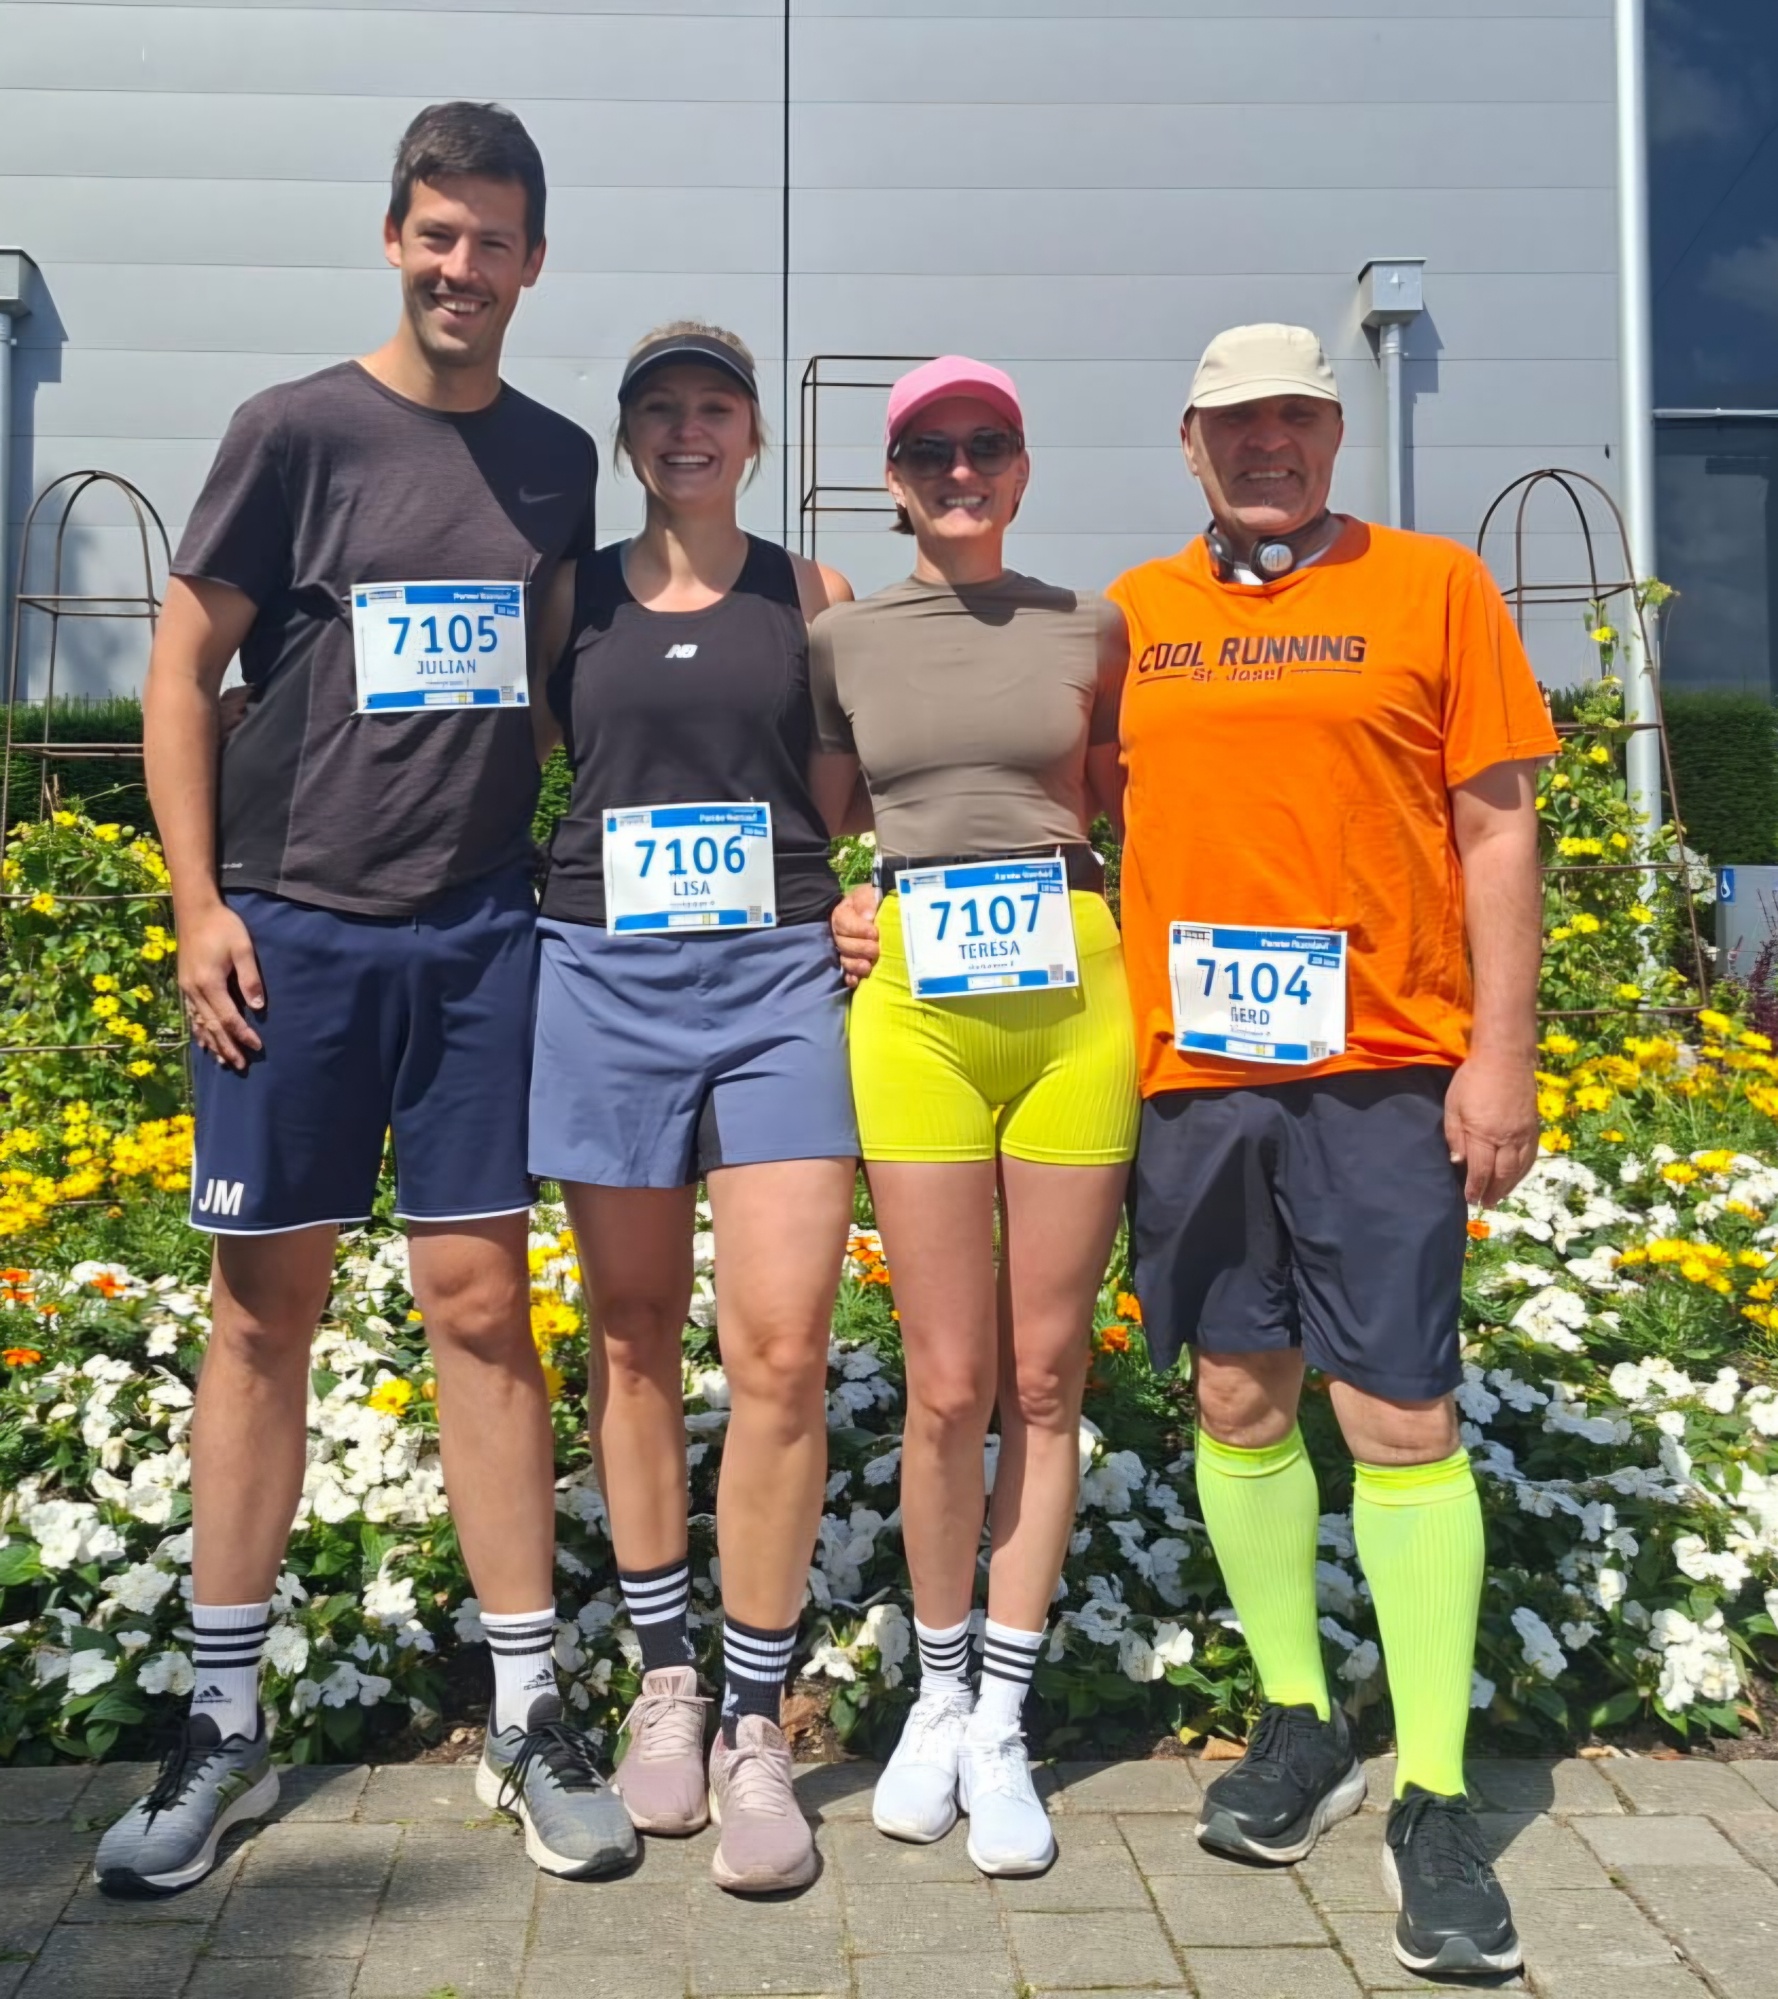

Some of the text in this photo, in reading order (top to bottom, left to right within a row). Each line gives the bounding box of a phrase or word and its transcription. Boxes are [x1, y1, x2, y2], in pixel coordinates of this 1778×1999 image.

[388, 614, 498, 655] 7105
[416, 659, 476, 675] JULIAN
[1138, 635, 1367, 674] COOL RUNNING
[635, 836, 745, 878] 7106
[674, 880, 711, 896] LISA
[930, 893, 1040, 941] 7107
[958, 940, 1020, 960] TERESA
[1197, 958, 1312, 1006] 7104
[199, 1178, 245, 1216] JM
